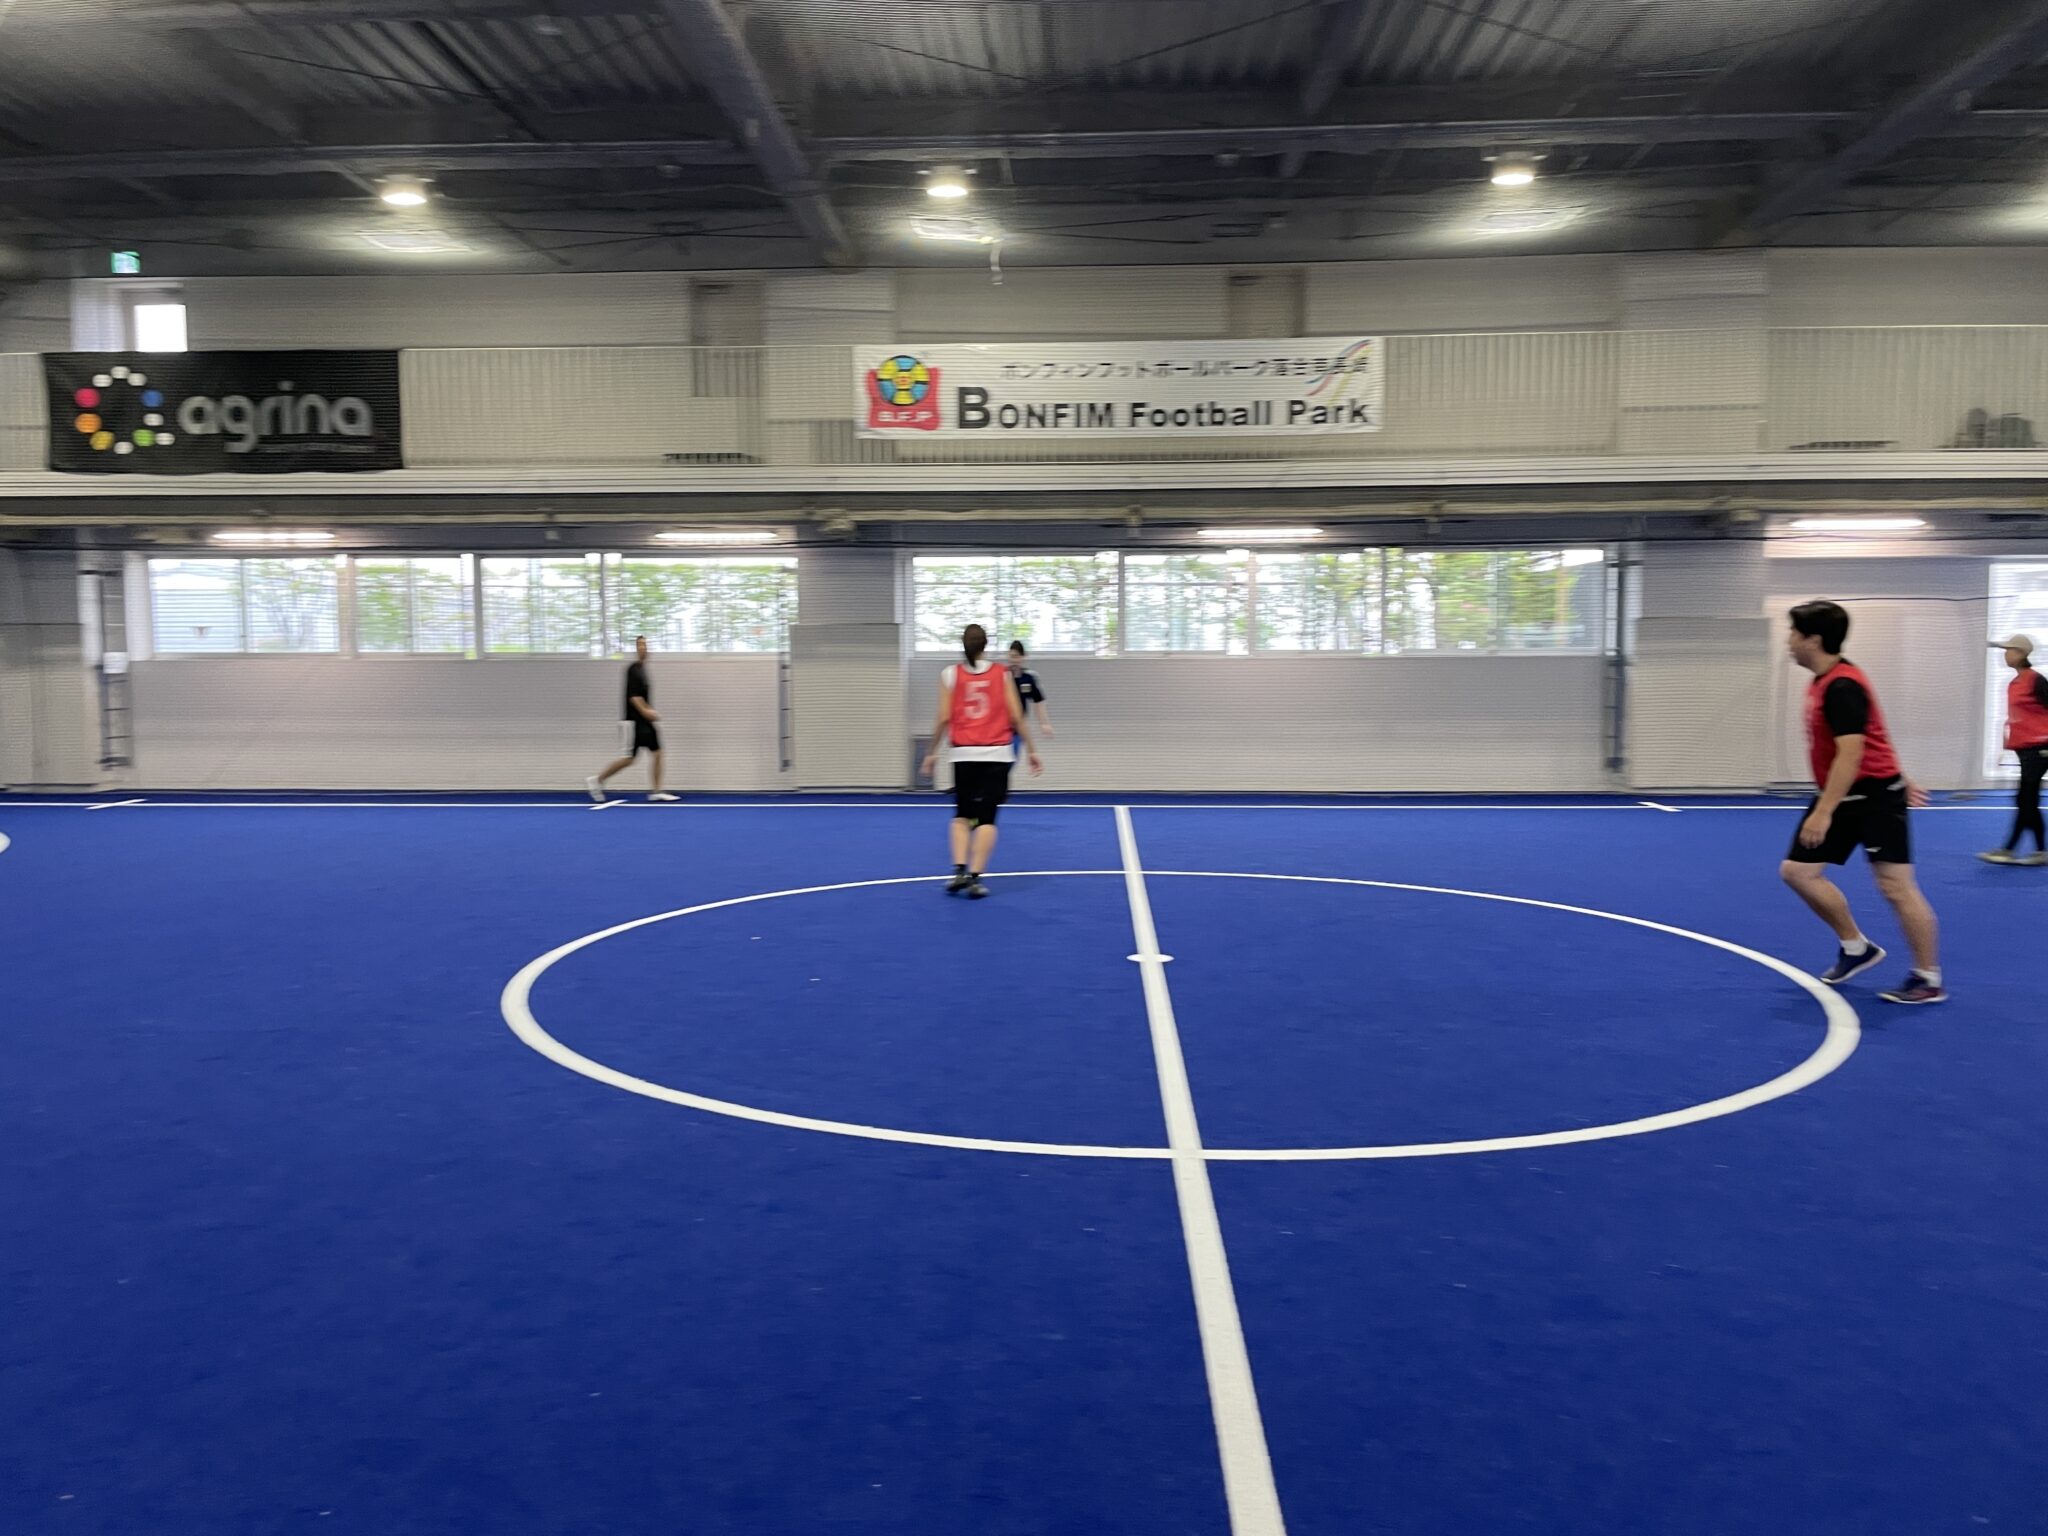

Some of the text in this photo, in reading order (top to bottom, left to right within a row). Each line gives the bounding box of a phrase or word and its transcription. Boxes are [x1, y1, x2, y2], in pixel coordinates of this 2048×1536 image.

[177, 380, 374, 454] agrina
[957, 386, 1369, 429] BONFIM Football Park
[964, 680, 992, 720] 5
